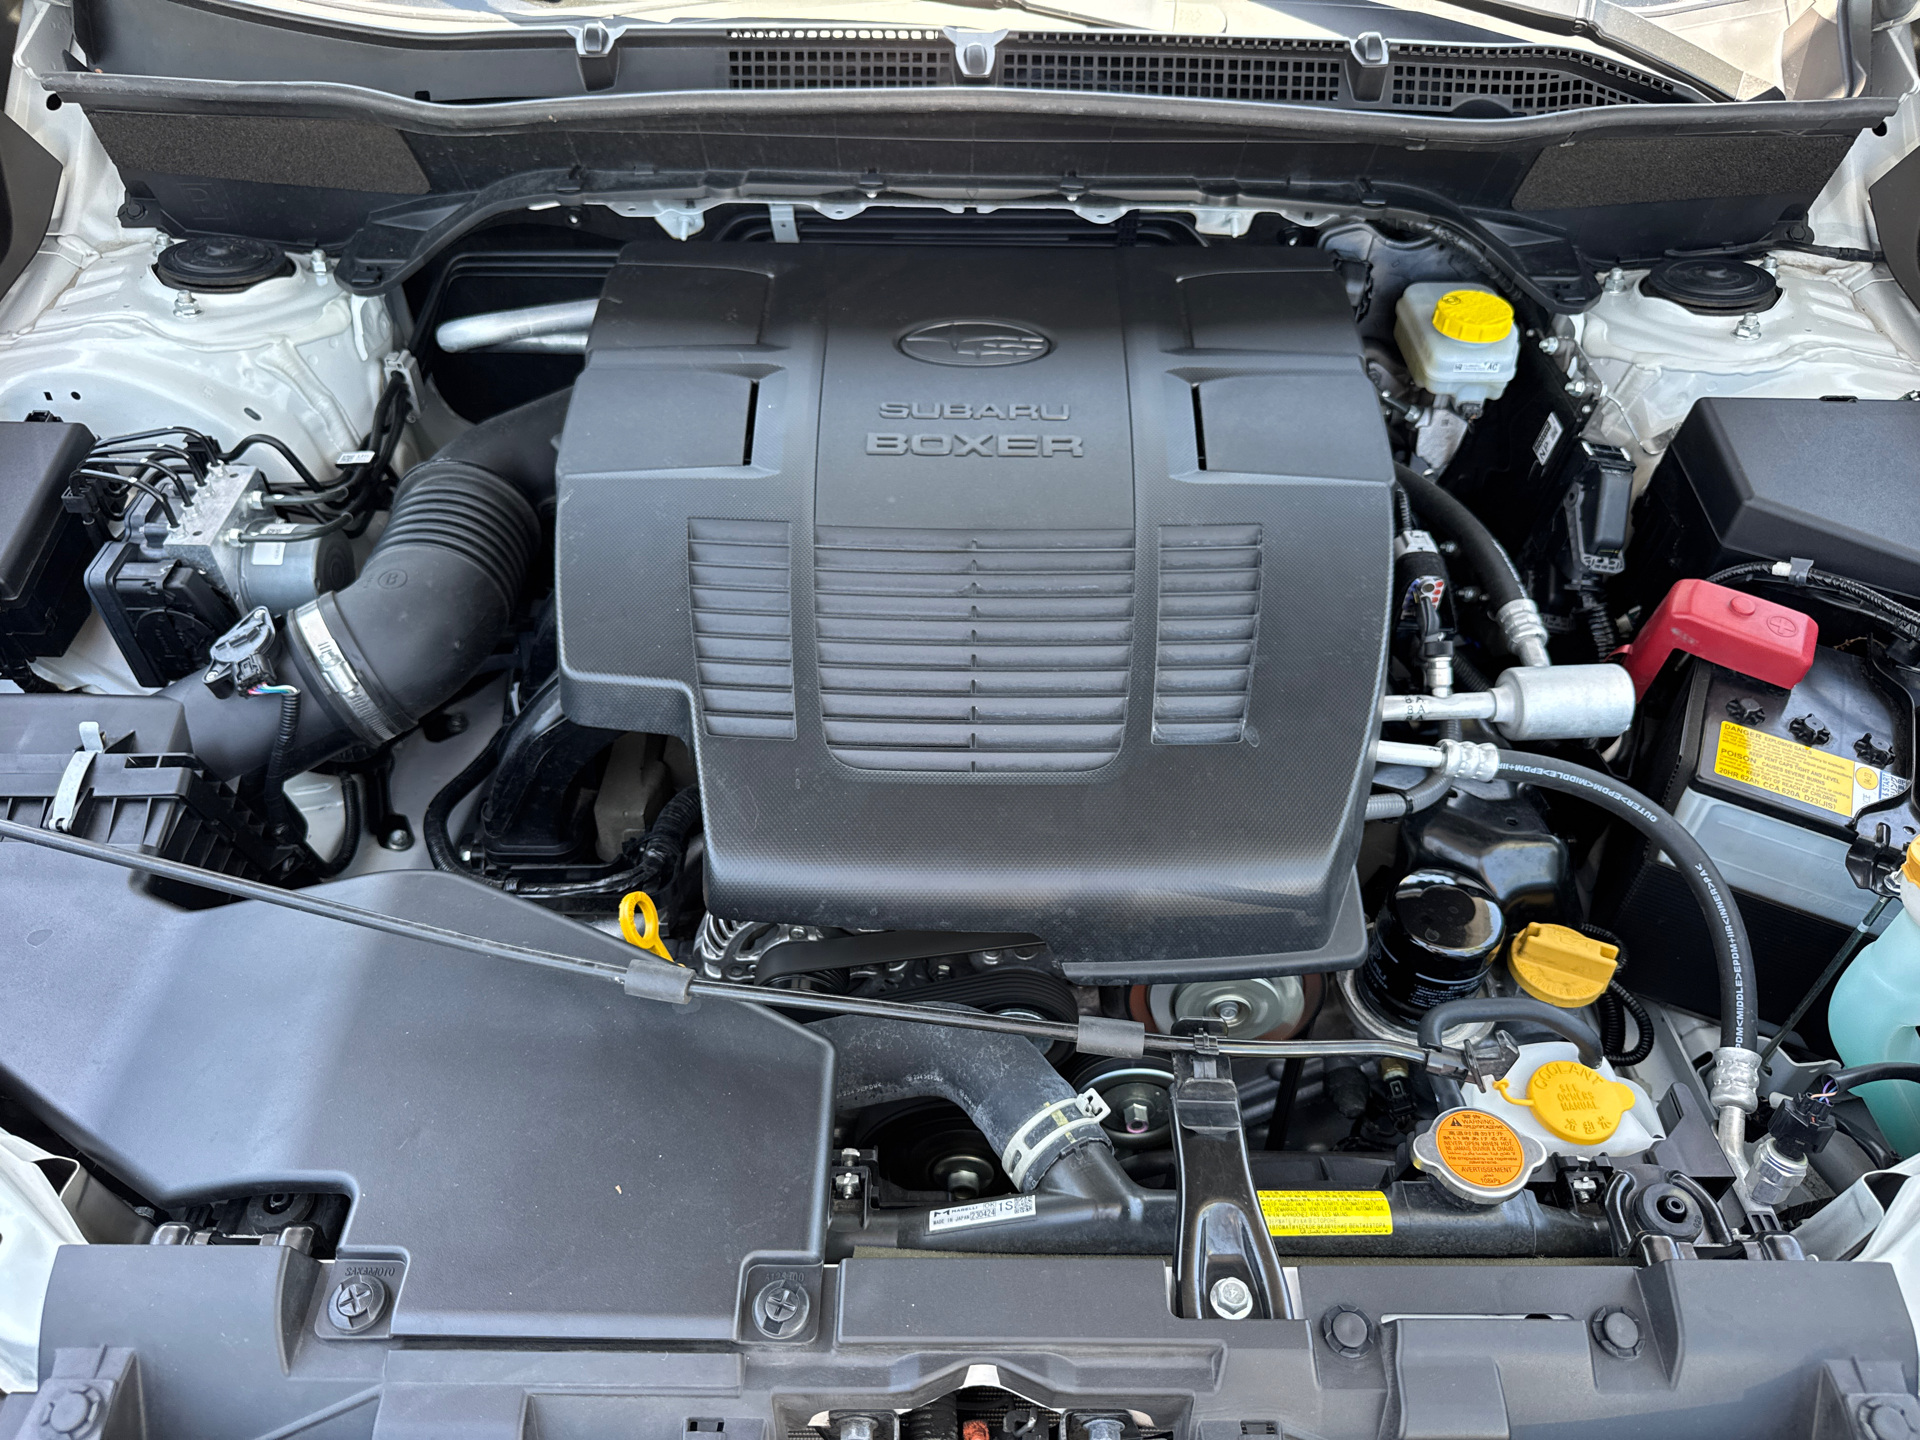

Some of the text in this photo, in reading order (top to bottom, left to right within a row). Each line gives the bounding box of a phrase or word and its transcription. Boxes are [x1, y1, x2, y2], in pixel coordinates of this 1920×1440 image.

[879, 402, 1070, 421] SUBARU
[865, 432, 1084, 457] BOXER
[1724, 723, 1761, 739] DANGER
[1720, 747, 1756, 764] POISON
[1718, 766, 1739, 778] 20HR
[1740, 773, 1759, 785] 62Ah
[1762, 780, 1780, 791] CCA
[1781, 786, 1800, 798] 620A
[1803, 793, 1836, 810] D23(JIS)
[1809, 790, 1837, 804] CHILDREN
[1534, 1063, 1604, 1089] COOLANT
[1561, 1101, 1600, 1111] MANUAL
[345, 1267, 396, 1277] SAKAMOTO
